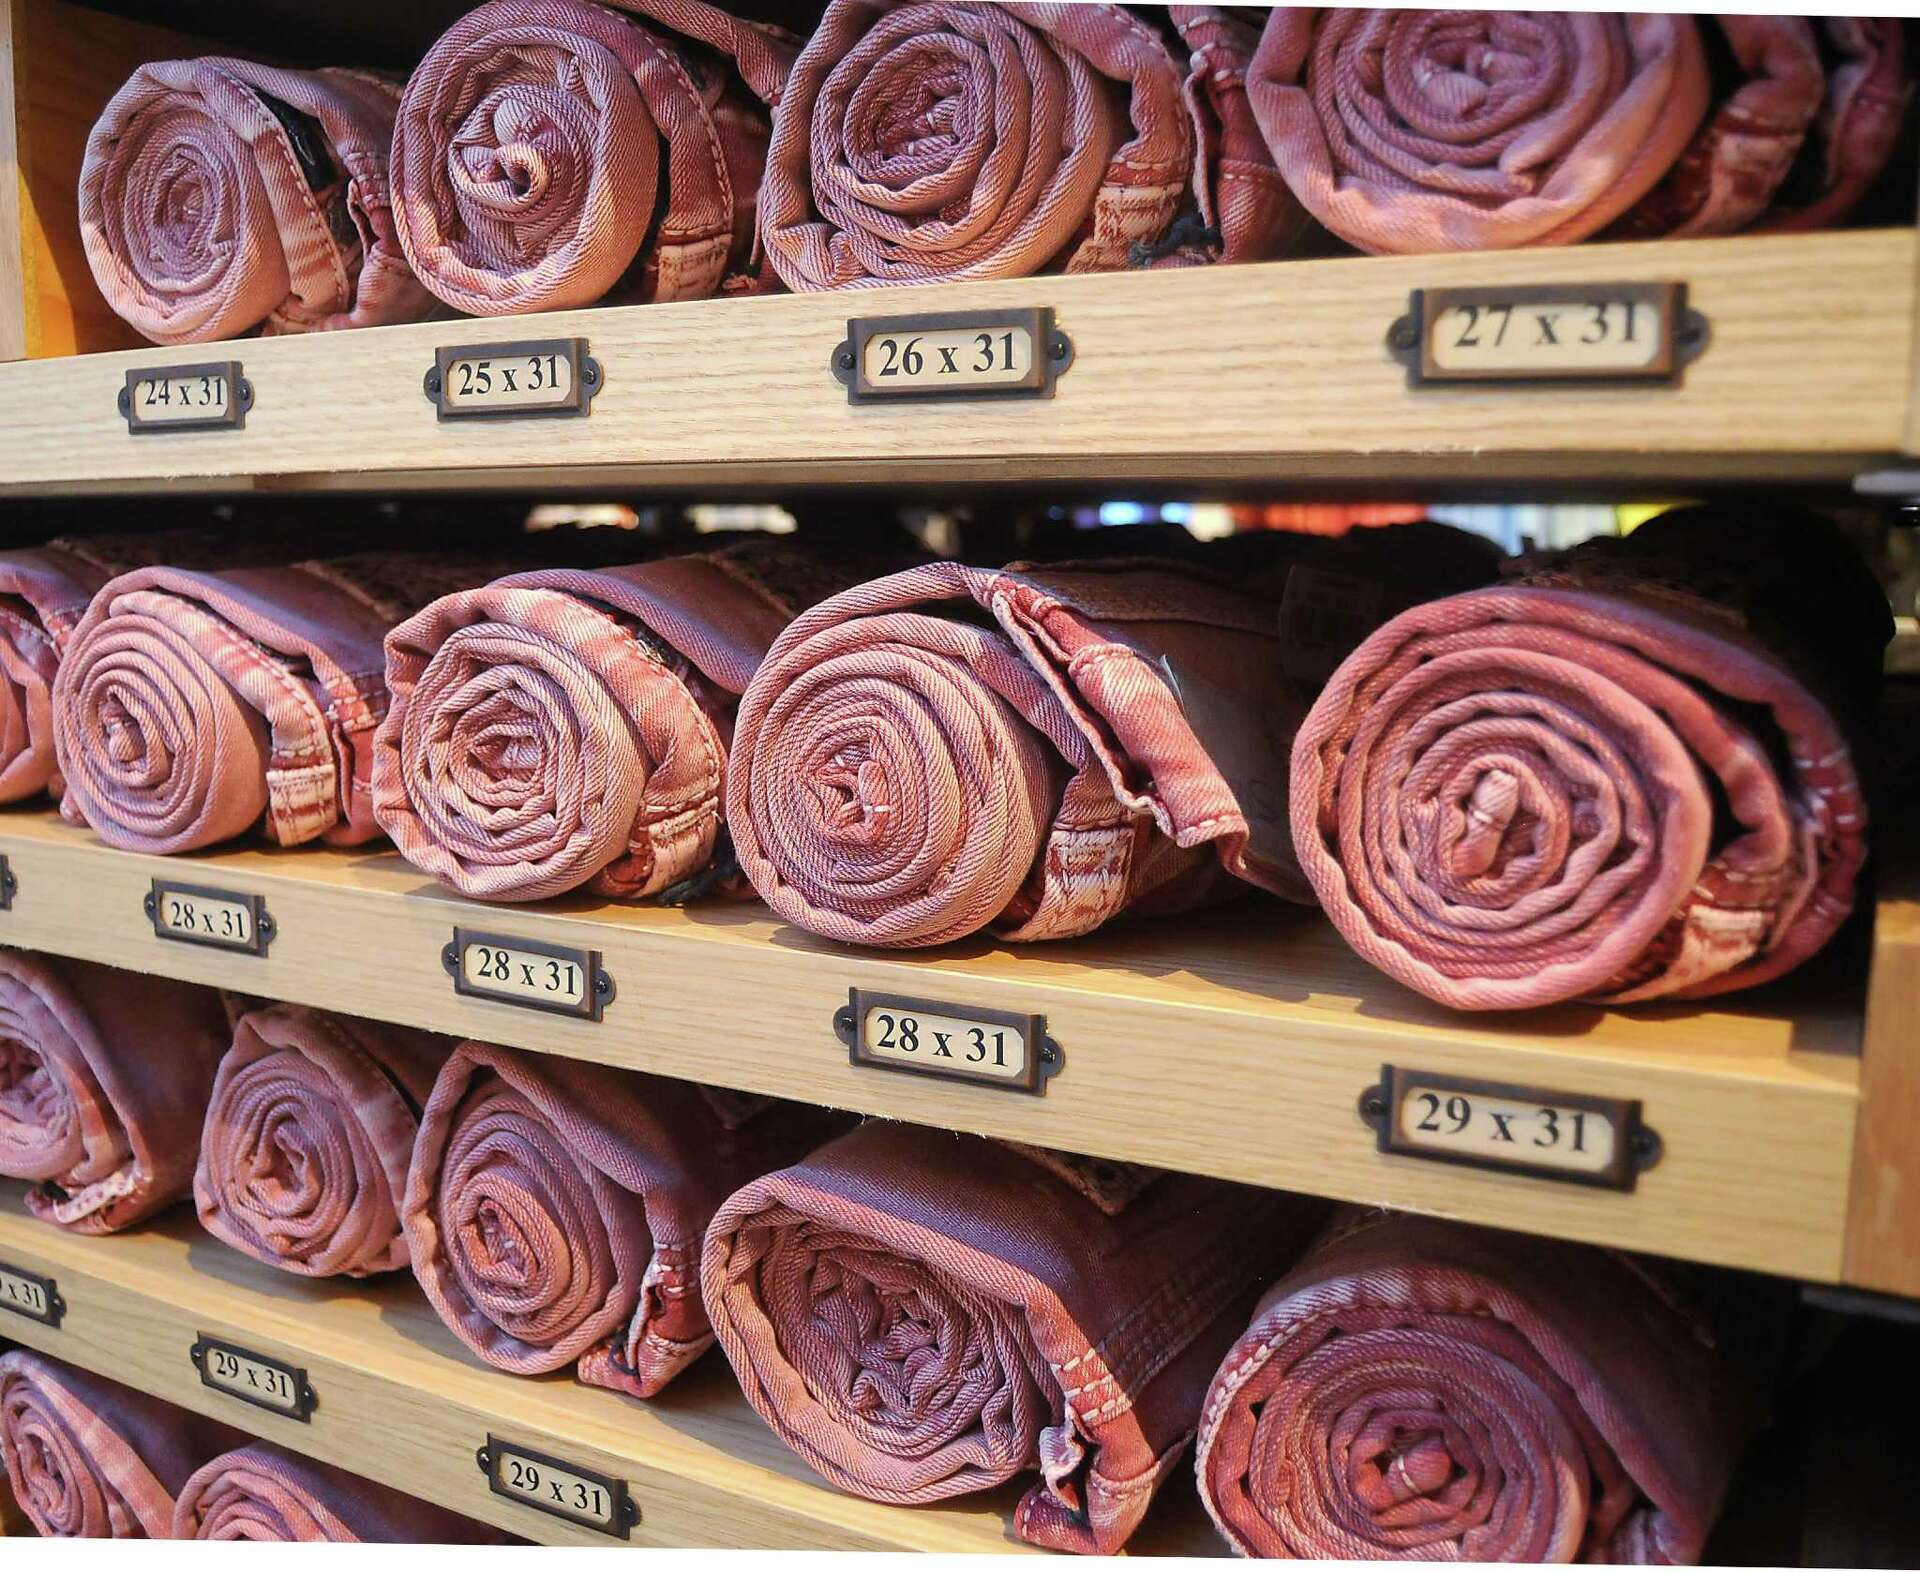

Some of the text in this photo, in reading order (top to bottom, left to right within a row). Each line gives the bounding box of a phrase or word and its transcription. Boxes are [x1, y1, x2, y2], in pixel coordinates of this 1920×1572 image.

[1454, 301, 1639, 347] 27 x 31
[458, 354, 560, 396] 25 x 31
[879, 331, 1017, 376] 26 x 31
[145, 376, 223, 405] 24 x 31
[170, 902, 246, 938] 28 x 31
[477, 947, 577, 996] 28 x 31
[876, 1014, 1008, 1067] 28 x 31
[1416, 1093, 1588, 1152] 29 x 31
[8, 1283, 41, 1308] x 31
[215, 1351, 289, 1399] 29 x 31
[510, 1460, 604, 1516] 29 x 31
